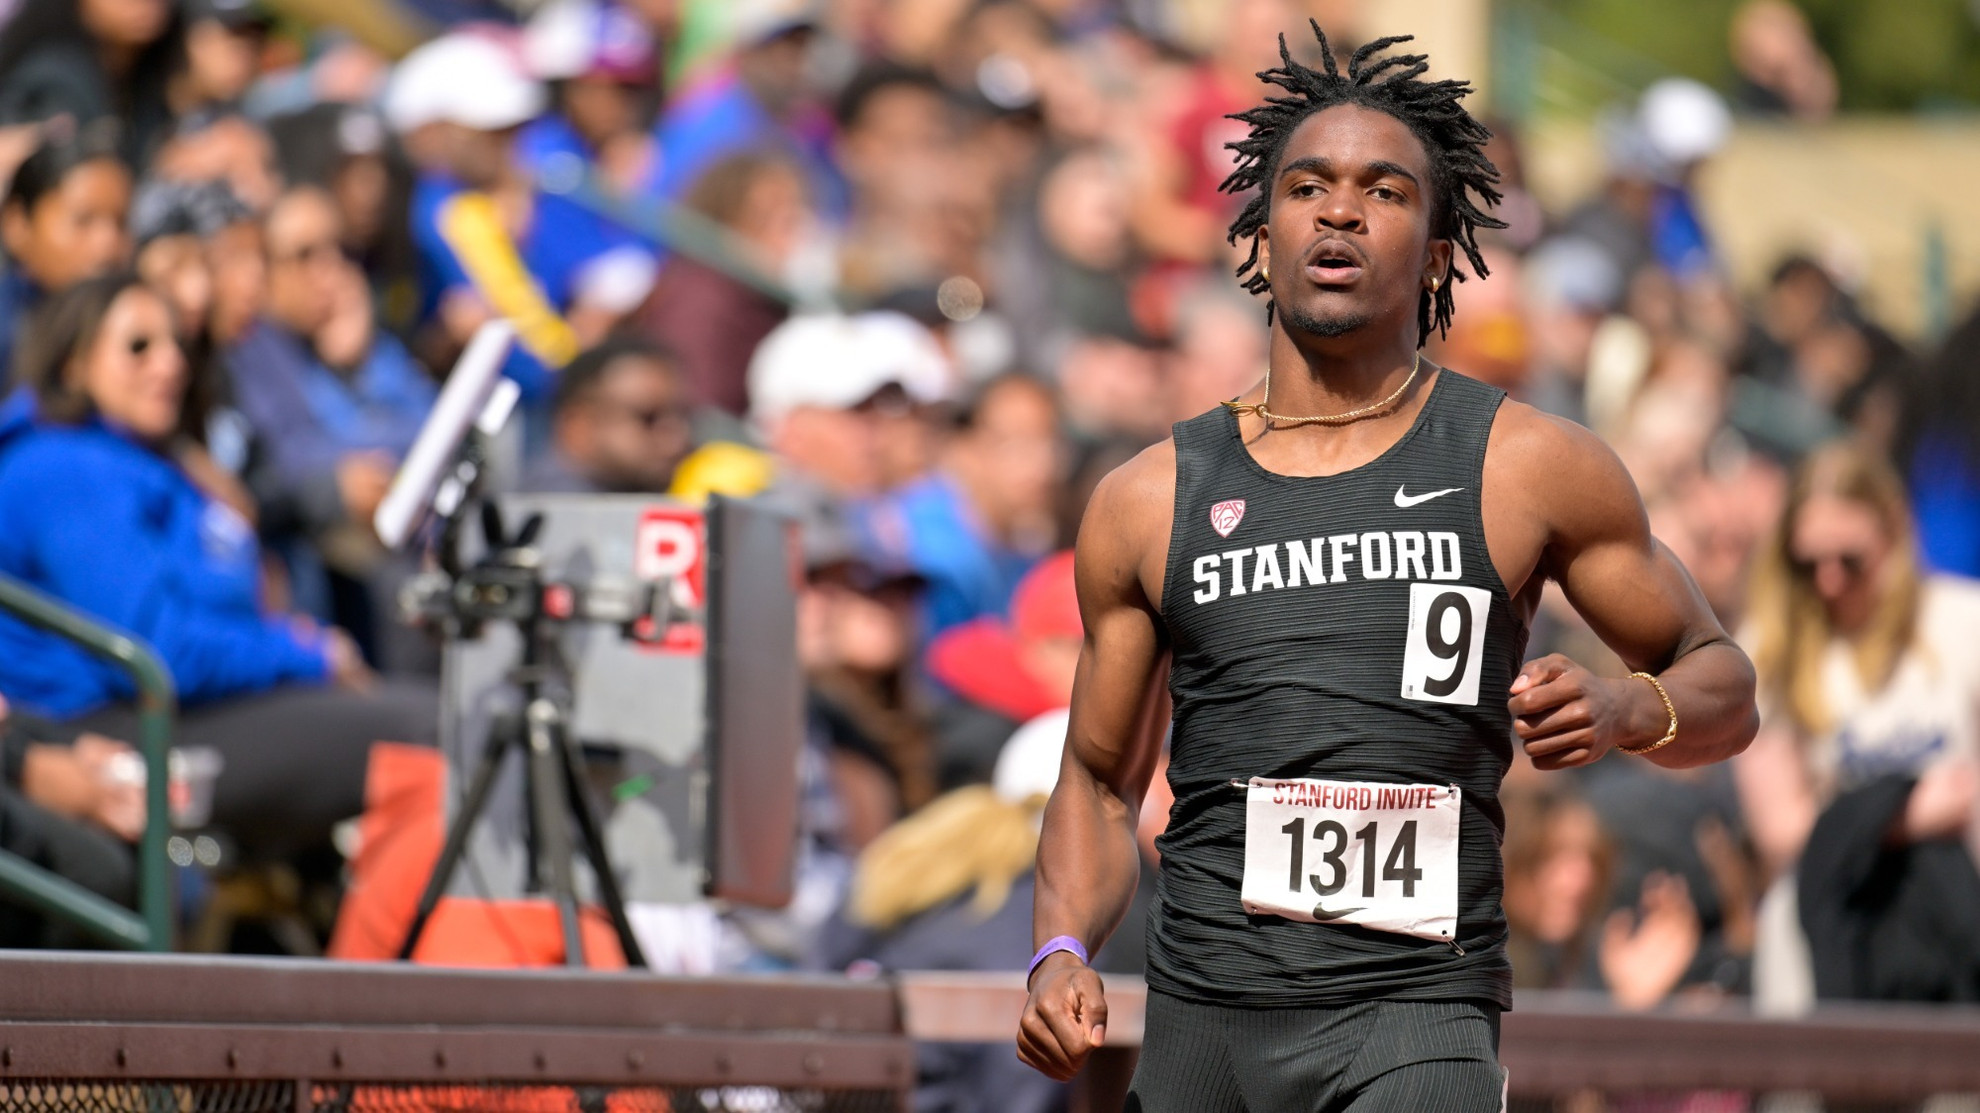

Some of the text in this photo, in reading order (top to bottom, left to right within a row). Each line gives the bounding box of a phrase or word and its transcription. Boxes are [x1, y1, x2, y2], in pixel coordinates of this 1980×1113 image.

[1213, 501, 1243, 523] PAC
[1219, 516, 1235, 530] 12
[1193, 531, 1463, 605] STANFORD
[1422, 591, 1473, 697] 9
[1273, 783, 1437, 811] STANFORD INVITE
[1281, 817, 1423, 898] 1314
